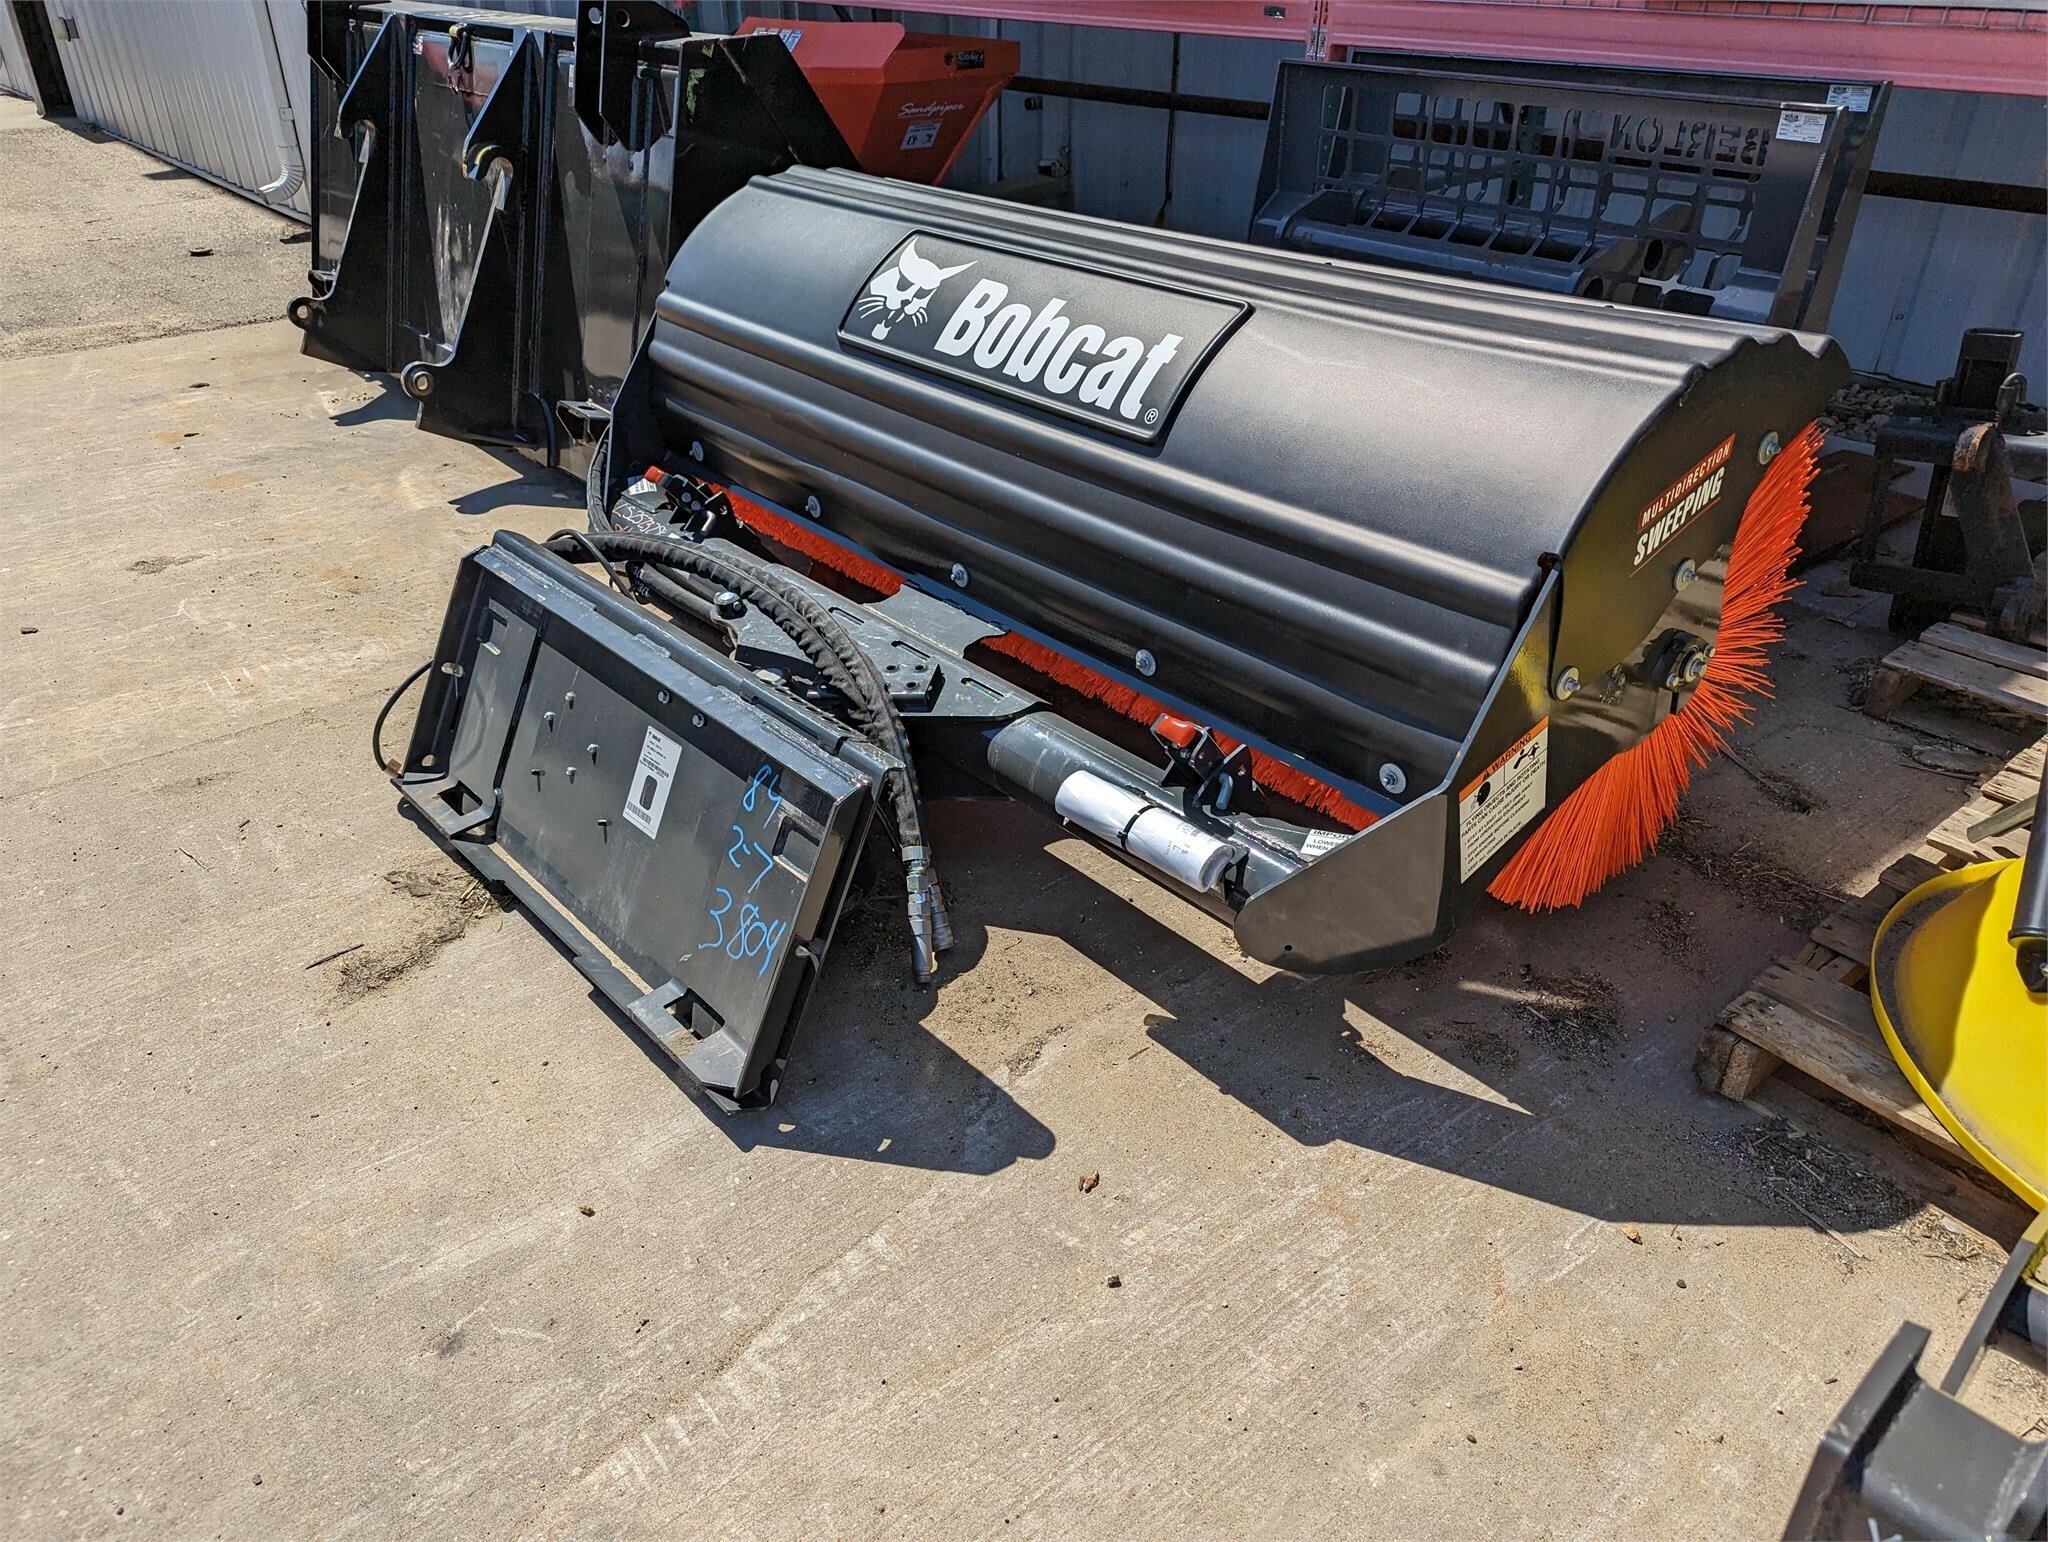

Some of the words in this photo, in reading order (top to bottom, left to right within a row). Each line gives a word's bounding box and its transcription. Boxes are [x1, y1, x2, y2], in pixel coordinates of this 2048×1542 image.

[934, 279, 1184, 420] Bobcat
[1633, 466, 1725, 566] SWEEPING
[1640, 441, 1731, 527] MULTIDIRECTION
[1492, 732, 1532, 772] WARNING
[742, 764, 783, 829] 84
[1461, 820, 1476, 838] PARTS
[1477, 810, 1487, 824] CAN
[1489, 795, 1503, 813] CAUSE
[1505, 779, 1521, 799] INJURY
[1466, 808, 1483, 827] FLYING
[1484, 788, 1505, 811] OBJECTS
[1506, 778, 1516, 791] AND
[1517, 757, 1539, 782] ROTATING
[1306, 843, 1329, 851] WHEN
